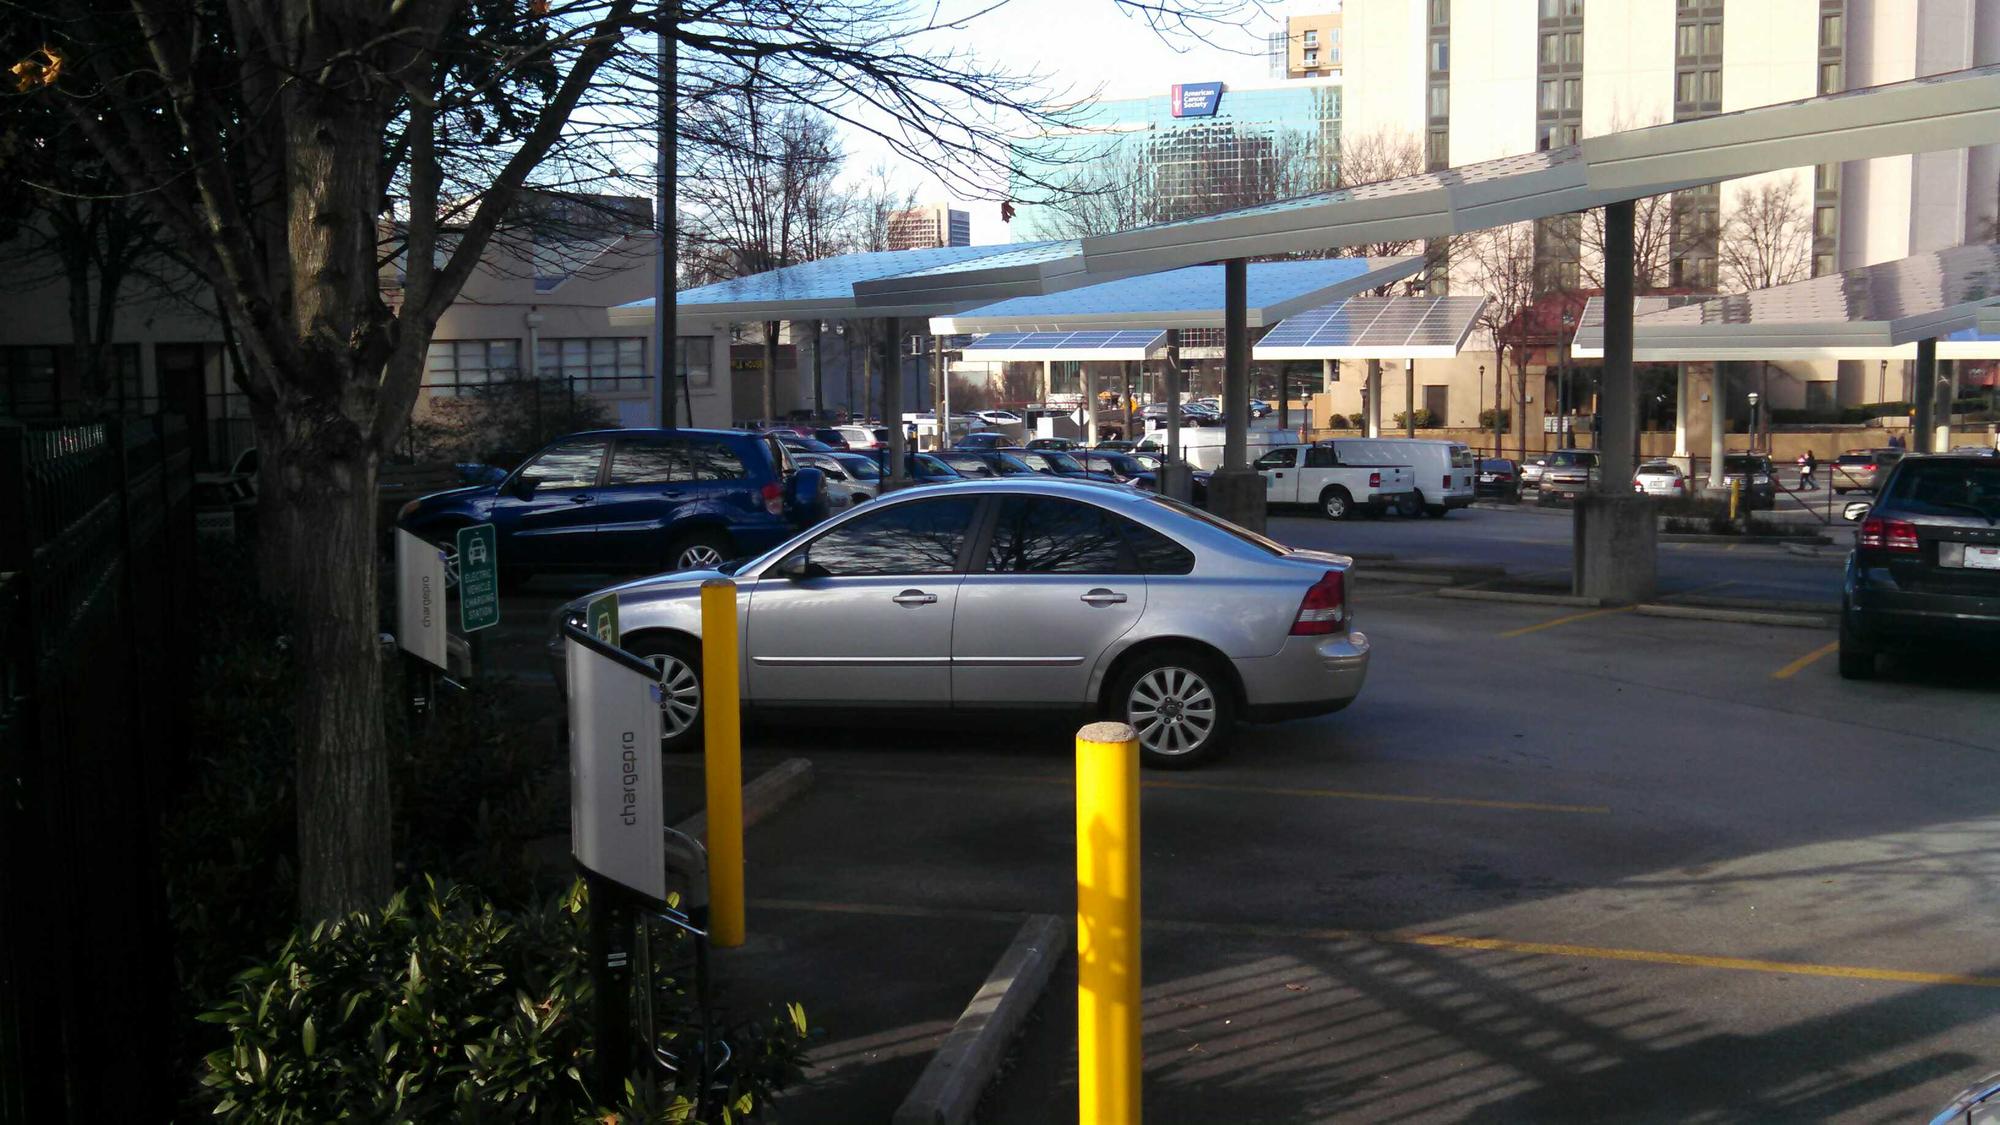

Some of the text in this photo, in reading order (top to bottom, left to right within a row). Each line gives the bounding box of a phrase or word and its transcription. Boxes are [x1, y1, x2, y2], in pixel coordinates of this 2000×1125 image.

[1184, 89, 1215, 97] American
[1184, 101, 1208, 109] Society
[620, 731, 638, 826] chargepro
